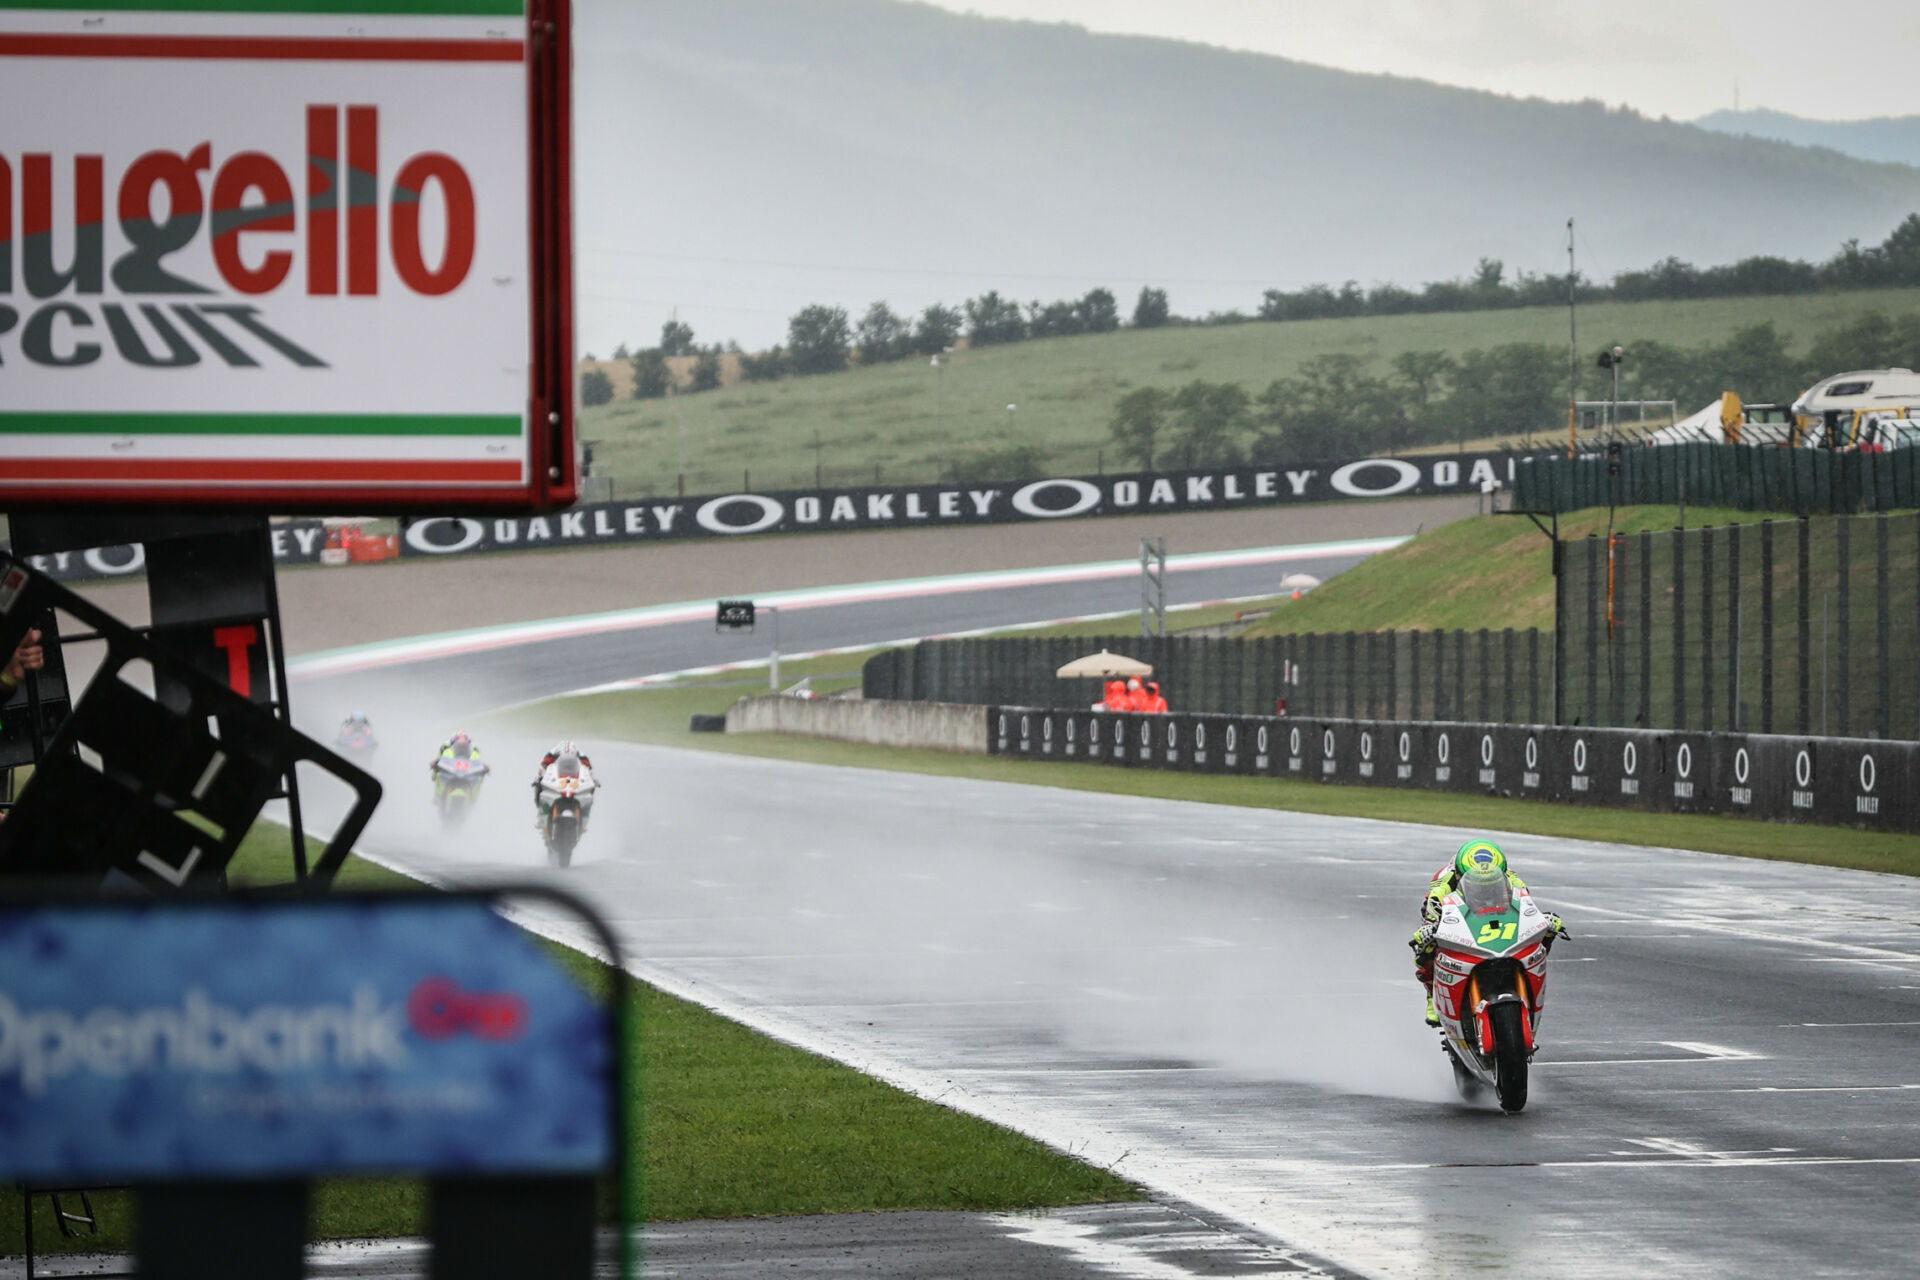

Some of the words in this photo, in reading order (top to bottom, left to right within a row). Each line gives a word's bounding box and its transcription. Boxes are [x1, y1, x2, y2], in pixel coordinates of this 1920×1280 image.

[0, 105, 475, 299] ugello
[0, 302, 331, 368] CUIT
[795, 490, 995, 523] OAKLEY
[1113, 470, 1311, 507] OAKLEY
[494, 505, 677, 543] OAKLEY
[1855, 794, 1880, 814] OAKLEY
[1477, 922, 1517, 944] 51
